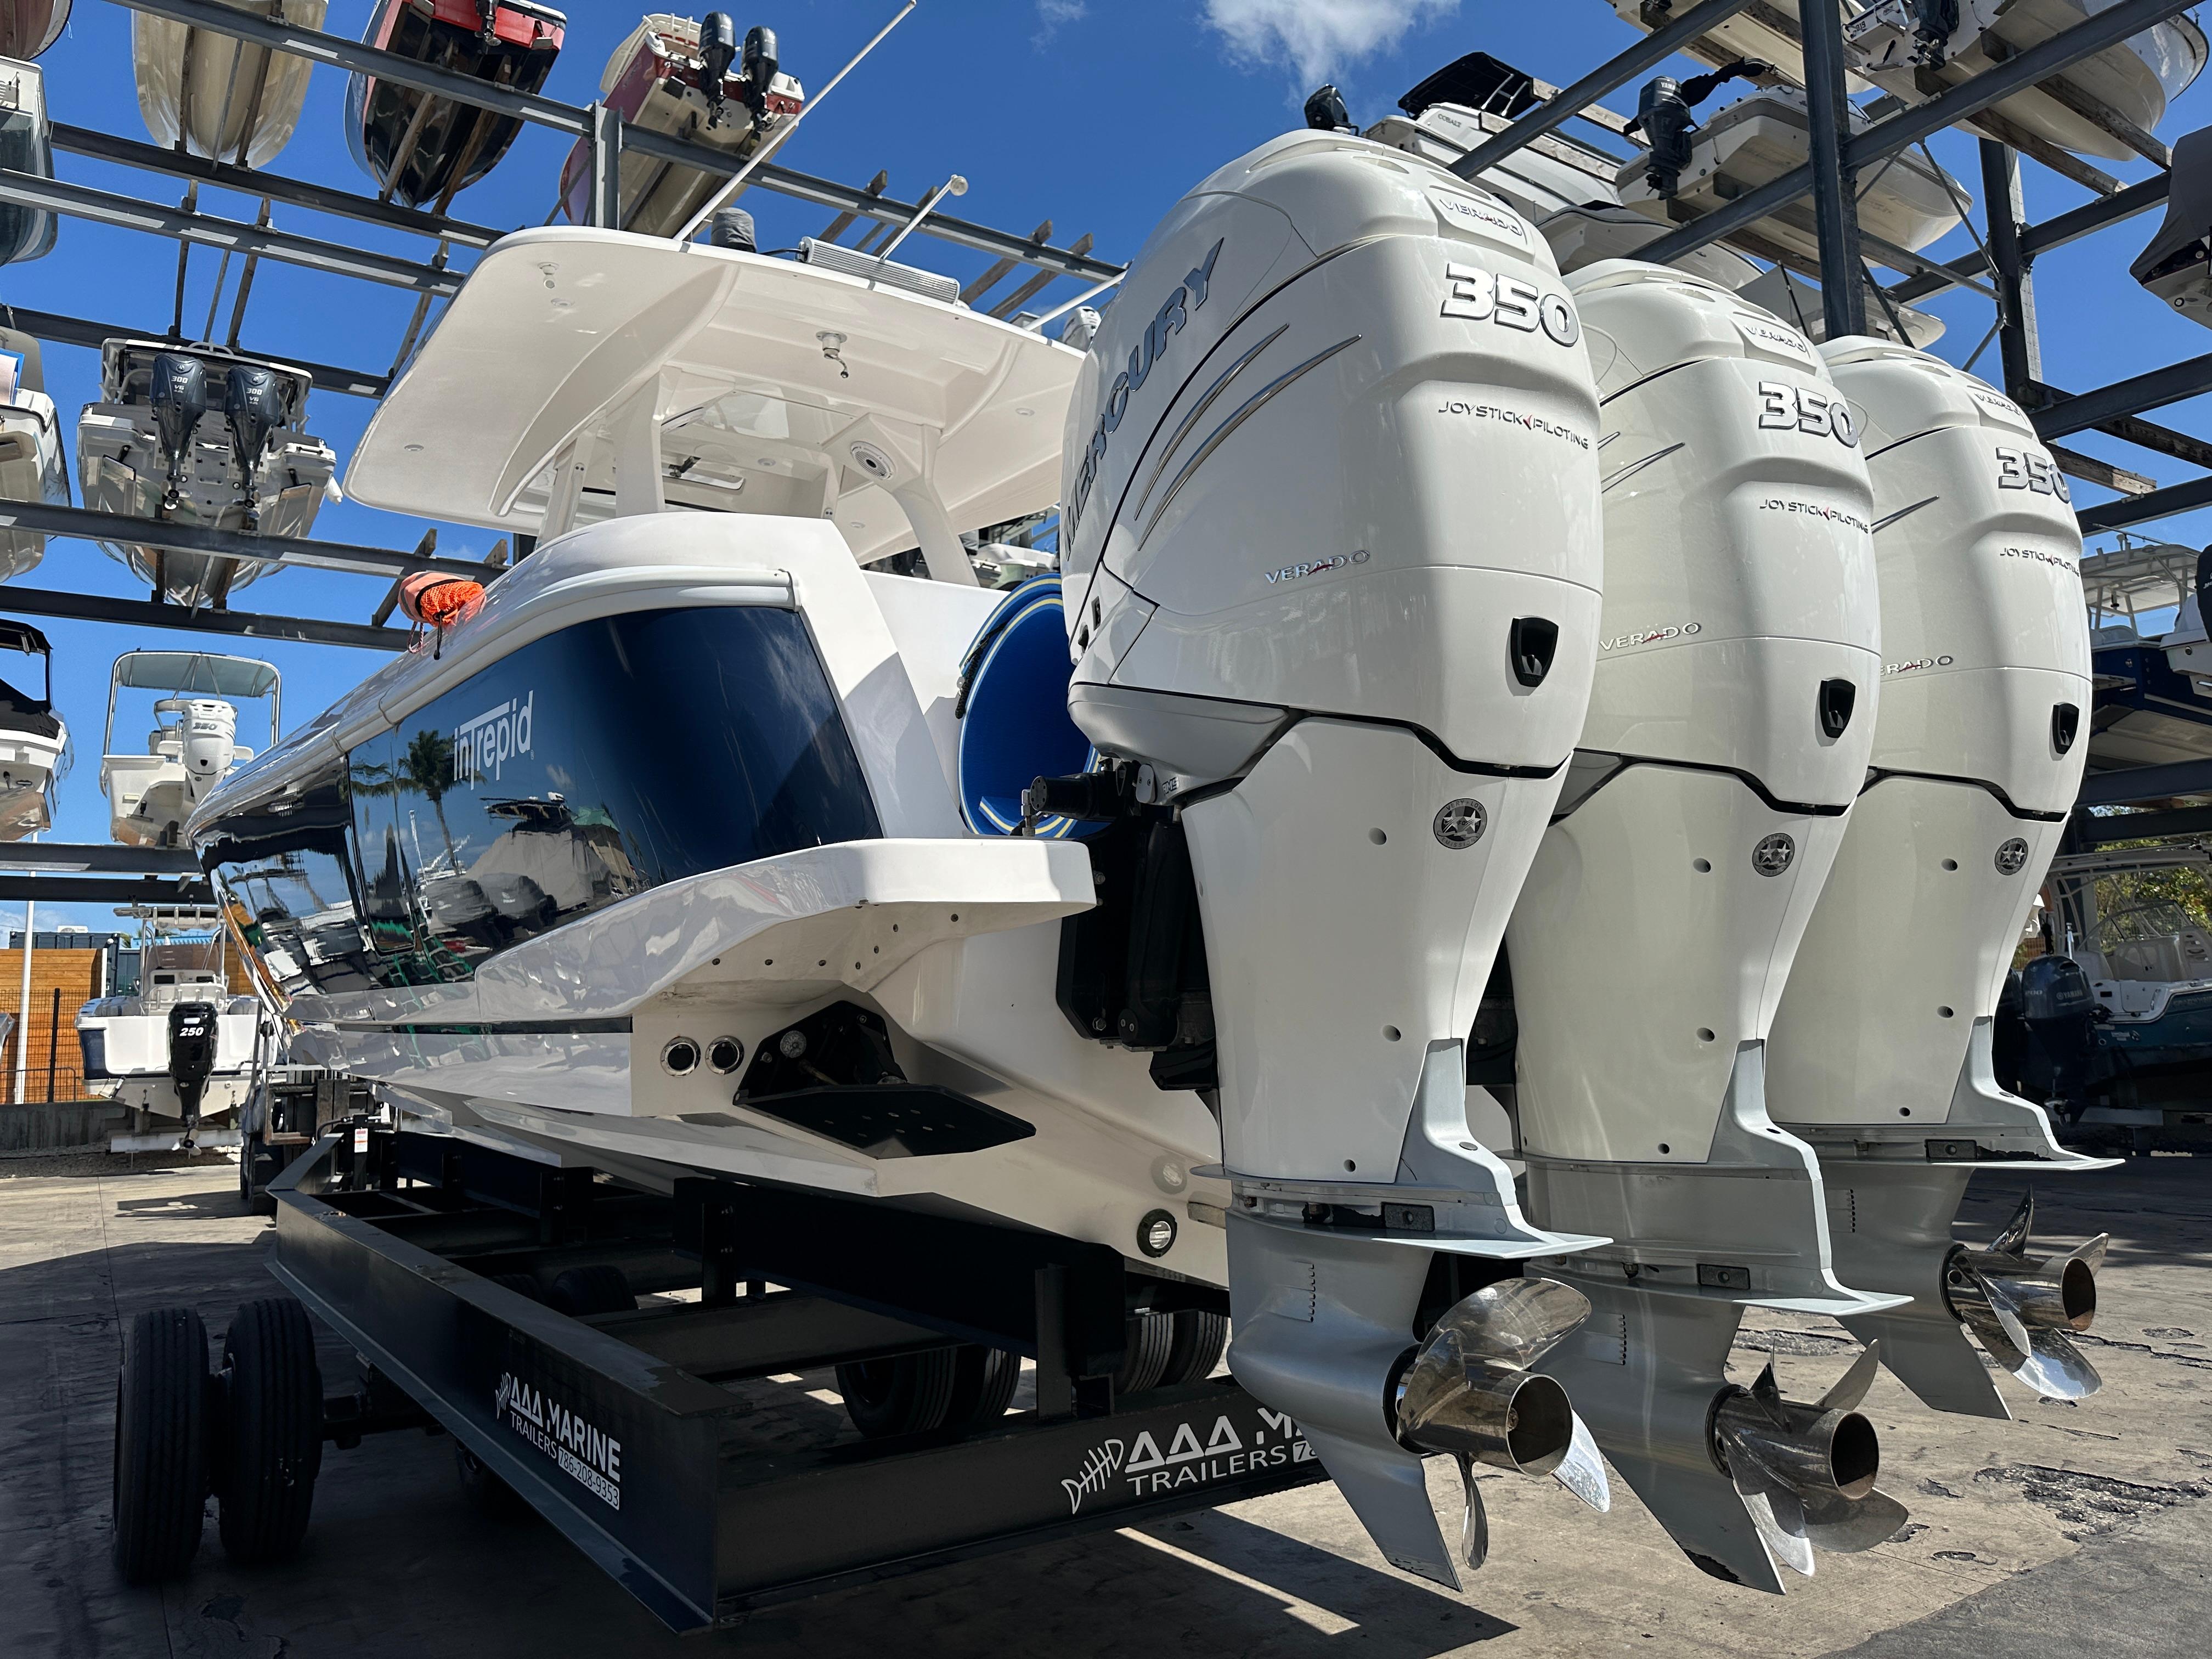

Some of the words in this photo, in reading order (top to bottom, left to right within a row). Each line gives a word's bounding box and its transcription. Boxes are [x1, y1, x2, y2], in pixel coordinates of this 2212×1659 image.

[1437, 114, 1462, 127] COBALT
[1440, 199, 1523, 236] VERADO
[1440, 261, 1579, 347] 350
[171, 376, 188, 384] 300
[1064, 237, 1224, 561] MERCURY
[1758, 381, 1858, 448] 350
[1438, 401, 1523, 425] JOYSTICK
[1533, 417, 1589, 450] PILOTING
[1996, 446, 2070, 504] 350
[1759, 499, 1823, 517] JOYSTICK
[1830, 510, 1868, 534] PILOTING
[1264, 549, 1370, 584] VERADO
[1599, 622, 1702, 651] VERADO
[1880, 656, 1954, 676] ERADO
[1446, 800, 1465, 810] VERY
[1470, 800, 1483, 812] LOW
[179, 1026, 204, 1036] 250
[510, 1410, 557, 1459] TRAILERS
[559, 1448, 619, 1507] 786-208-9353
[546, 1398, 620, 1482] MARINE
[1126, 1445, 1286, 1496] TRAILERS
